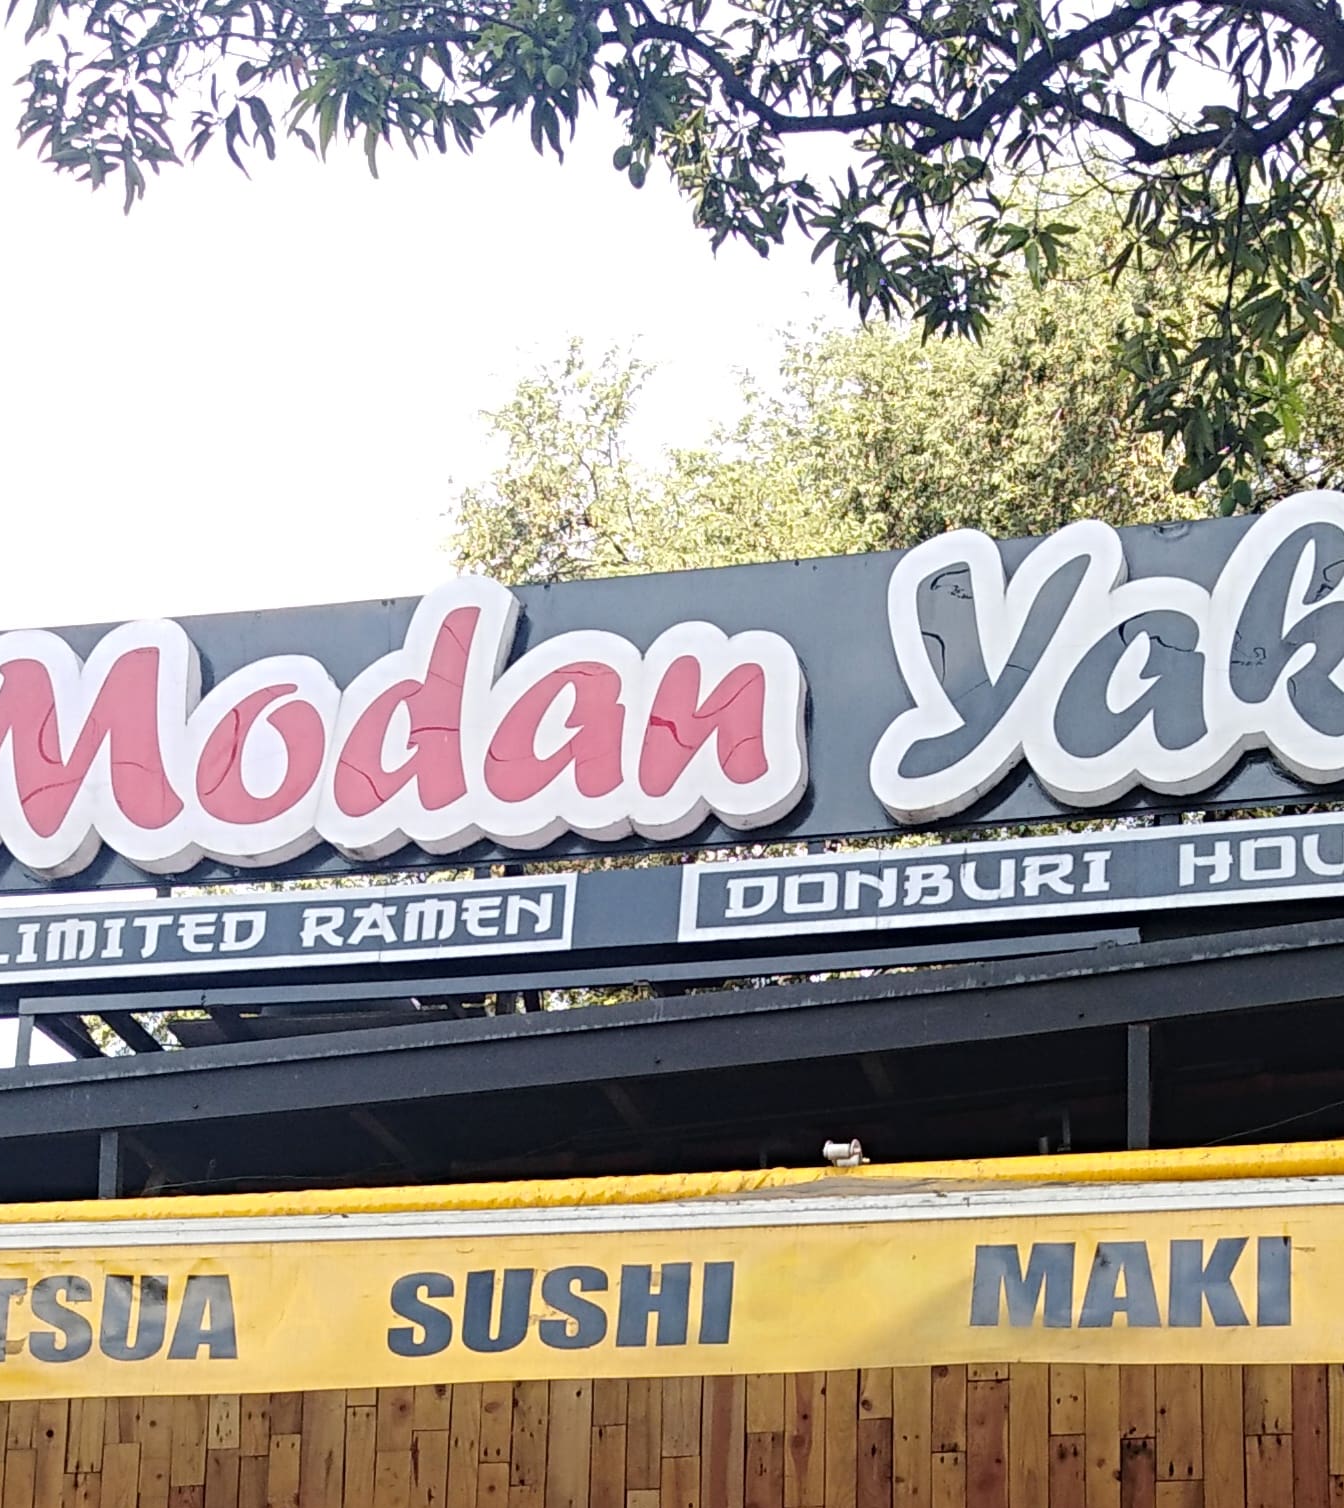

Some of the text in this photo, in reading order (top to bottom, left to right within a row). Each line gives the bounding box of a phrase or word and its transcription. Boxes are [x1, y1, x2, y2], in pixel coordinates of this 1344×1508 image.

[299, 891, 555, 949] RAMEN
[724, 849, 1113, 920] DONBURI
[385, 1260, 735, 1358] SUSHI
[969, 1234, 1292, 1329] MAKI
